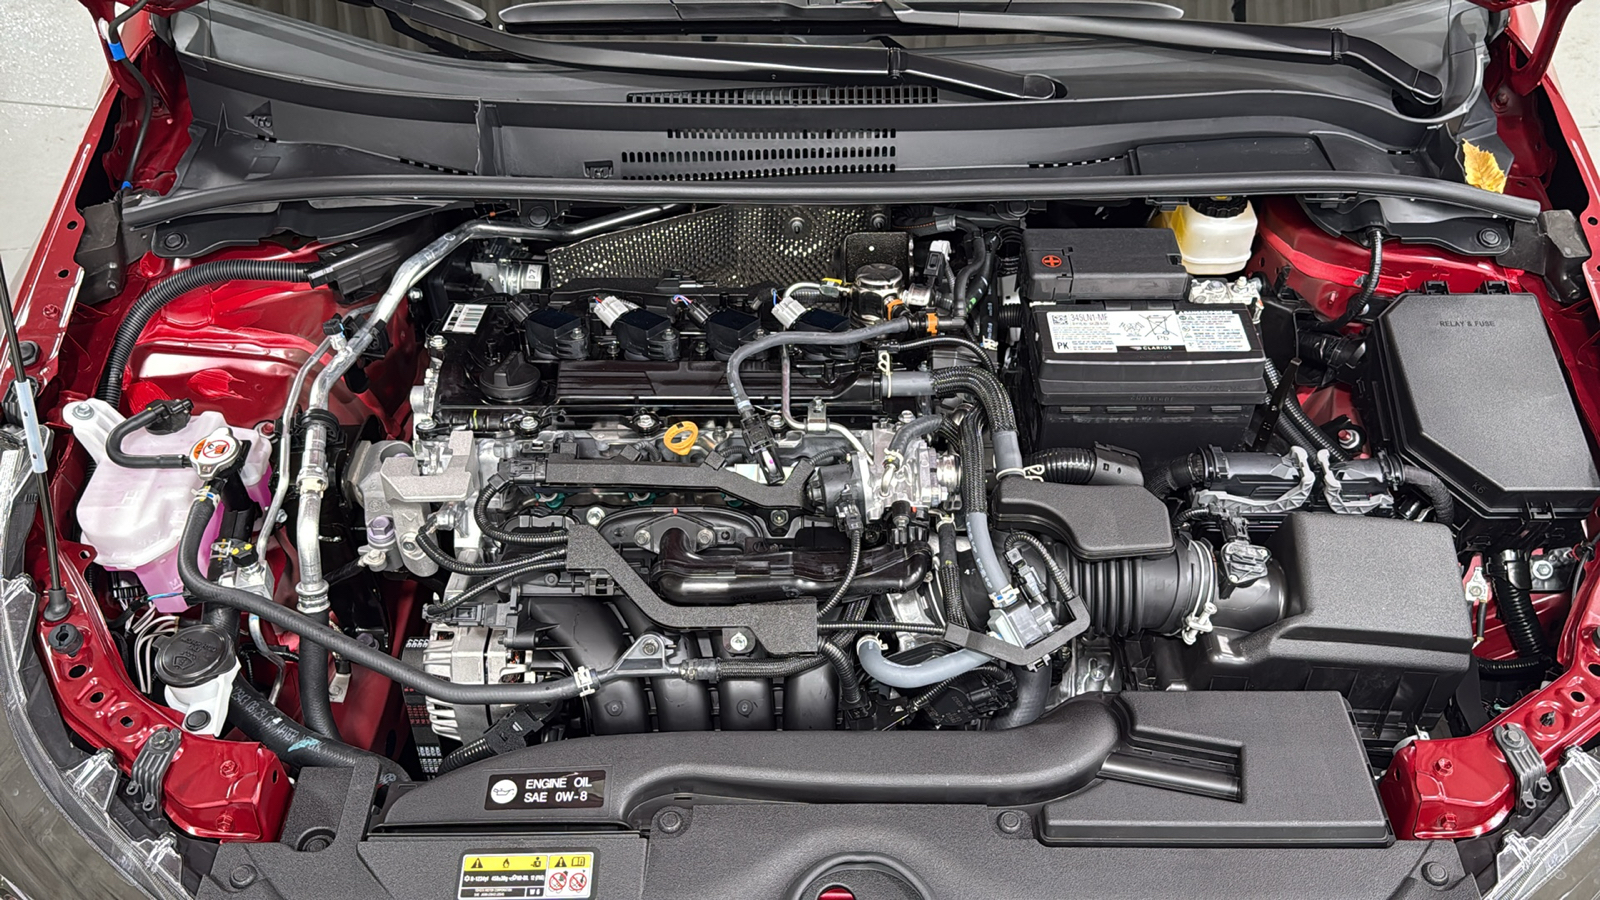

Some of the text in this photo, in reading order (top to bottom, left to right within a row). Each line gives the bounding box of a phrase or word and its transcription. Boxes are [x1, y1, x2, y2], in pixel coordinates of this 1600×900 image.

[1056, 341, 1069, 350] PK
[525, 776, 593, 790] ENGINE OIL
[523, 790, 588, 803] SAE 0W-8
